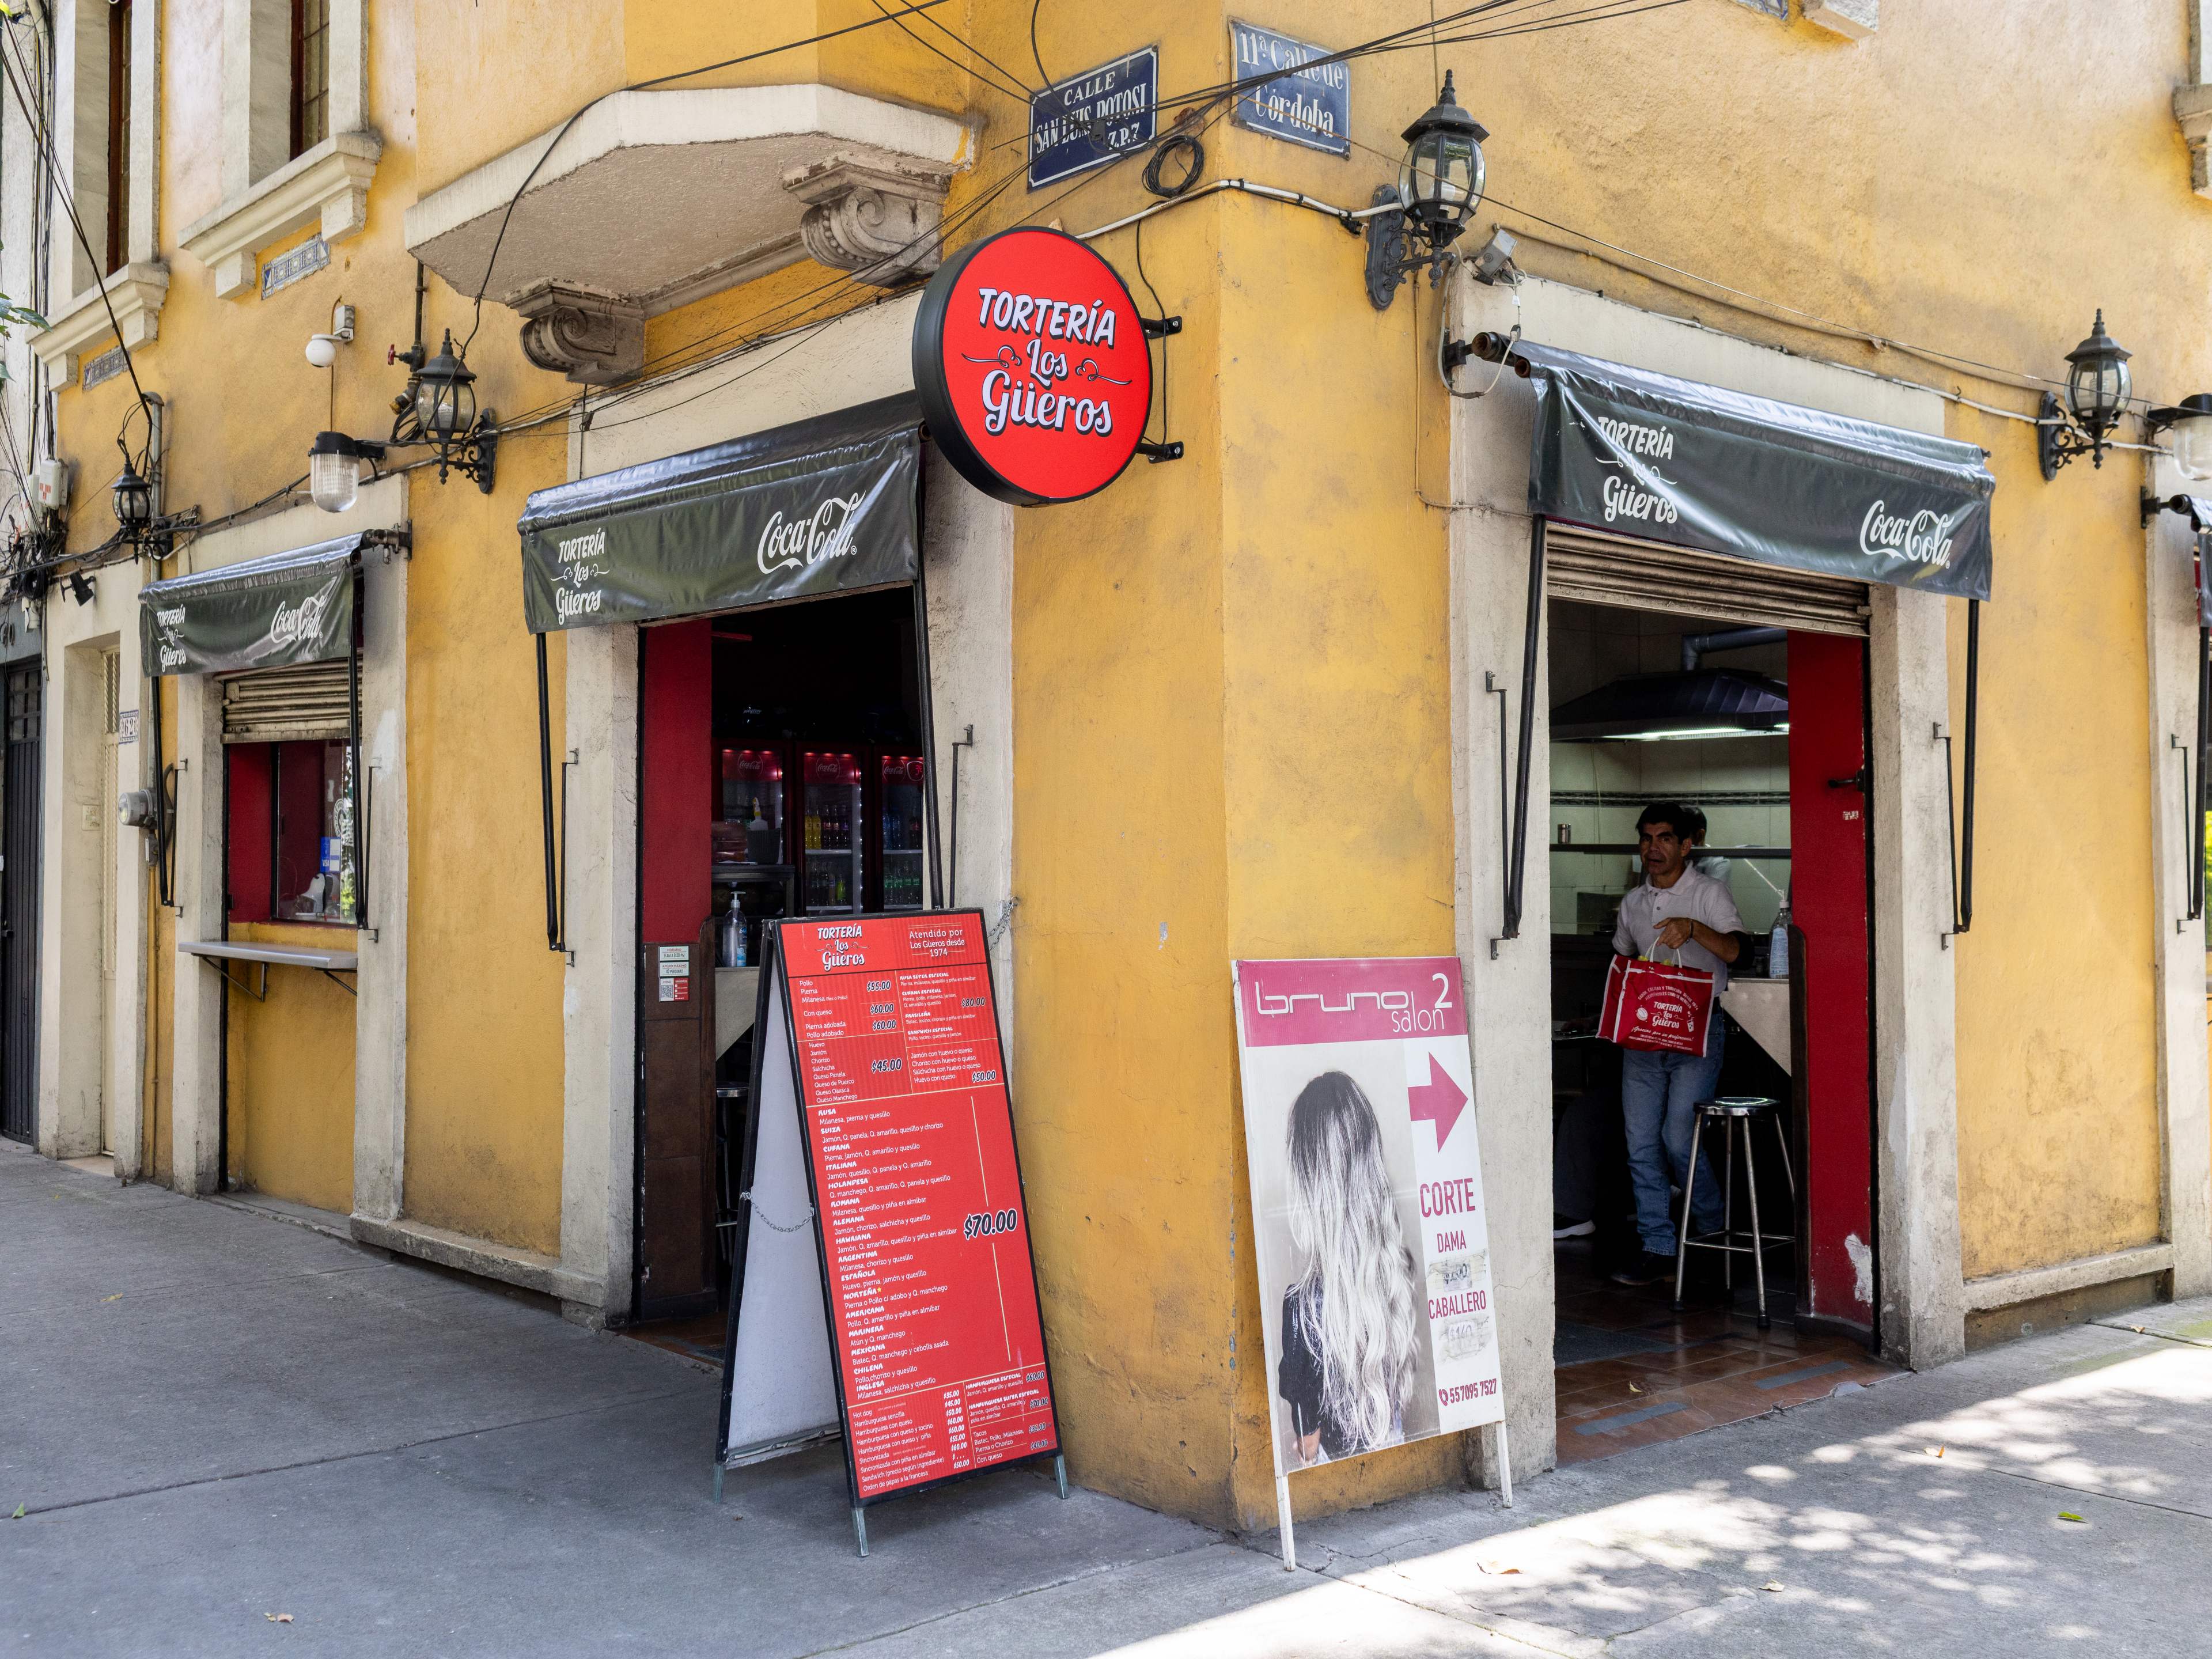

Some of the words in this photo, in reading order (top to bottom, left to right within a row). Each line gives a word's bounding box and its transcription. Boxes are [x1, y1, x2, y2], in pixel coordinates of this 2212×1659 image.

[1270, 40, 1320, 82] Calle
[1323, 58, 1343, 90] de
[1064, 71, 1115, 106] CALLE
[1255, 85, 1334, 138] Córdoba
[1036, 118, 1059, 154] SAN
[979, 287, 1116, 349] TORTERÍA
[1026, 338, 1069, 390] Los
[981, 369, 1113, 437] Güeros
[1597, 416, 1674, 460] TORTERÍA
[1603, 475, 1678, 524] Güeros
[757, 490, 866, 575] Coca-Cola
[1859, 499, 1955, 569] Coca-Cola
[558, 527, 605, 563] TORTERÍA
[573, 560, 589, 589] Los
[555, 587, 602, 626] Güeros
[160, 645, 187, 673] Güeros
[817, 923, 862, 940] TORTERÍA
[909, 929, 946, 939] Atendido
[949, 929, 963, 937] por
[834, 939, 849, 954] Los
[922, 940, 945, 948] Güeros
[946, 938, 965, 946] desde
[930, 948, 948, 957] 1974
[821, 951, 865, 972] Güeros
[866, 980, 891, 993] $55.00
[1431, 972, 1453, 1009] 2
[961, 997, 986, 1009] $80.00
[1255, 981, 1410, 1014] bruno
[870, 1002, 895, 1016] $60.00
[1391, 991, 1445, 1033] salon
[1654, 1001, 1683, 1013] TORTERÍA
[1652, 1015, 1680, 1029] Güeros
[1662, 1010, 1672, 1020] Los
[872, 1019, 897, 1032] $60.00
[821, 1029, 844, 1037] adobado
[871, 1058, 903, 1074] $45.00
[971, 1069, 997, 1084] $50.00
[818, 1108, 836, 1116] RUSA
[846, 1115, 864, 1123] pierna
[869, 1111, 891, 1120] quesillo
[820, 1126, 841, 1134] SUIZA
[825, 1161, 857, 1171] ITALIANA
[831, 1198, 860, 1207] ROMANA
[1419, 1177, 1476, 1218] CORTE
[833, 1215, 865, 1226] ALEMANA
[835, 1226, 855, 1236] Jamón,
[856, 1224, 878, 1232] chorizo,
[879, 1218, 905, 1228] salchicha
[910, 1214, 930, 1224] quesillo
[963, 1207, 1018, 1241] $70.00
[836, 1233, 871, 1244] HAWAIANA
[1437, 1229, 1467, 1253] DAMA
[838, 1251, 877, 1263] ARGENTINA
[840, 1263, 865, 1272] Milanesa,
[866, 1259, 887, 1267] chorizo
[892, 1253, 914, 1264] quesillo
[841, 1270, 876, 1282] ESPAÑOLA
[843, 1287, 877, 1300] NORTEÑA
[1428, 1290, 1487, 1320] CABALLERO
[846, 1306, 885, 1319] AMERICANA
[849, 1325, 884, 1338] MARINERA
[851, 1343, 885, 1356] MEXICANA
[853, 1363, 883, 1375] CHILENA
[1025, 1370, 1045, 1383] $60.00
[856, 1380, 885, 1392] INGLESA
[1479, 1378, 1497, 1397] 7527
[943, 1389, 960, 1400] $35.00
[945, 1398, 961, 1408] $45.00
[1029, 1396, 1049, 1410] $70.00
[854, 1416, 887, 1427] Hamburguesa
[887, 1411, 905, 1420] sencilla
[949, 1433, 965, 1443] $55.00
[859, 1452, 889, 1464] Sincronizada
